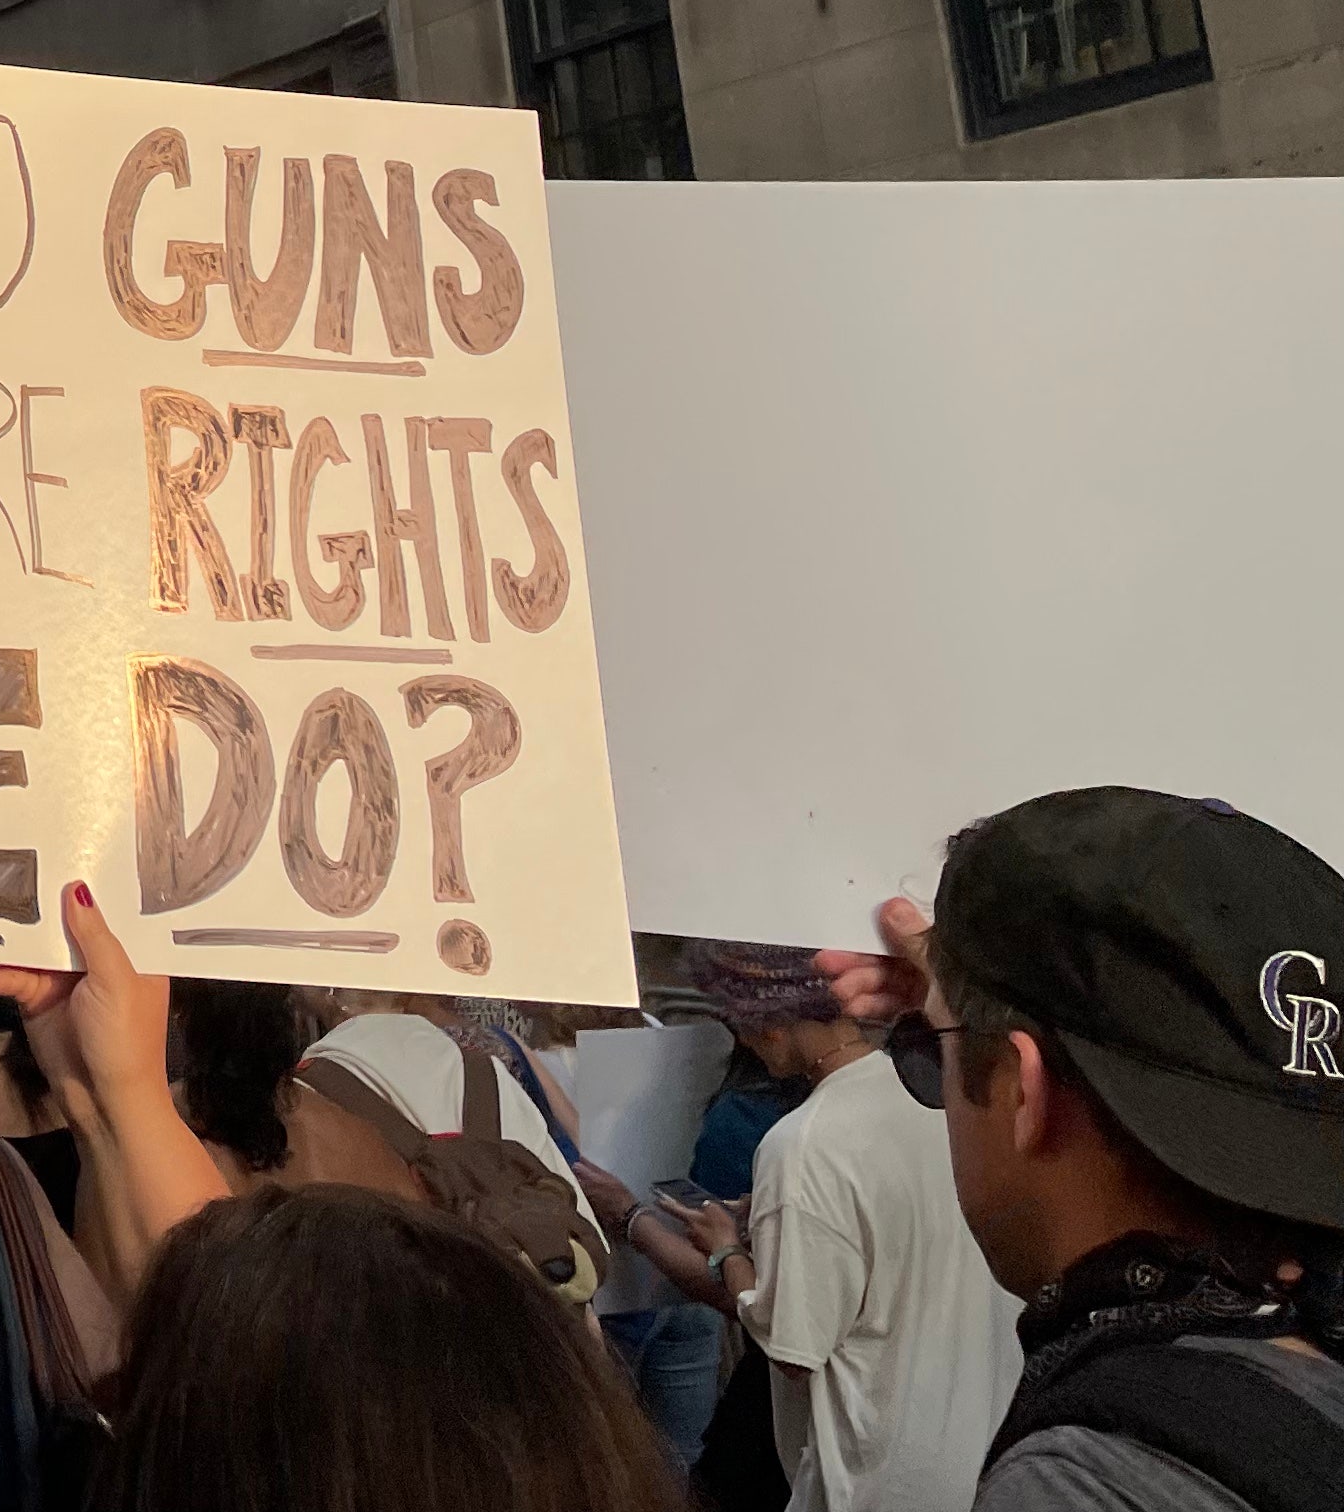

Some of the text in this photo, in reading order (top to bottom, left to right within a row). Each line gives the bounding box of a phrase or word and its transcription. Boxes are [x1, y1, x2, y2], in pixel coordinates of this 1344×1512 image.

[103, 125, 525, 359] GUNS
[139, 385, 572, 644] RIGHTS
[125, 651, 523, 976] DO?
